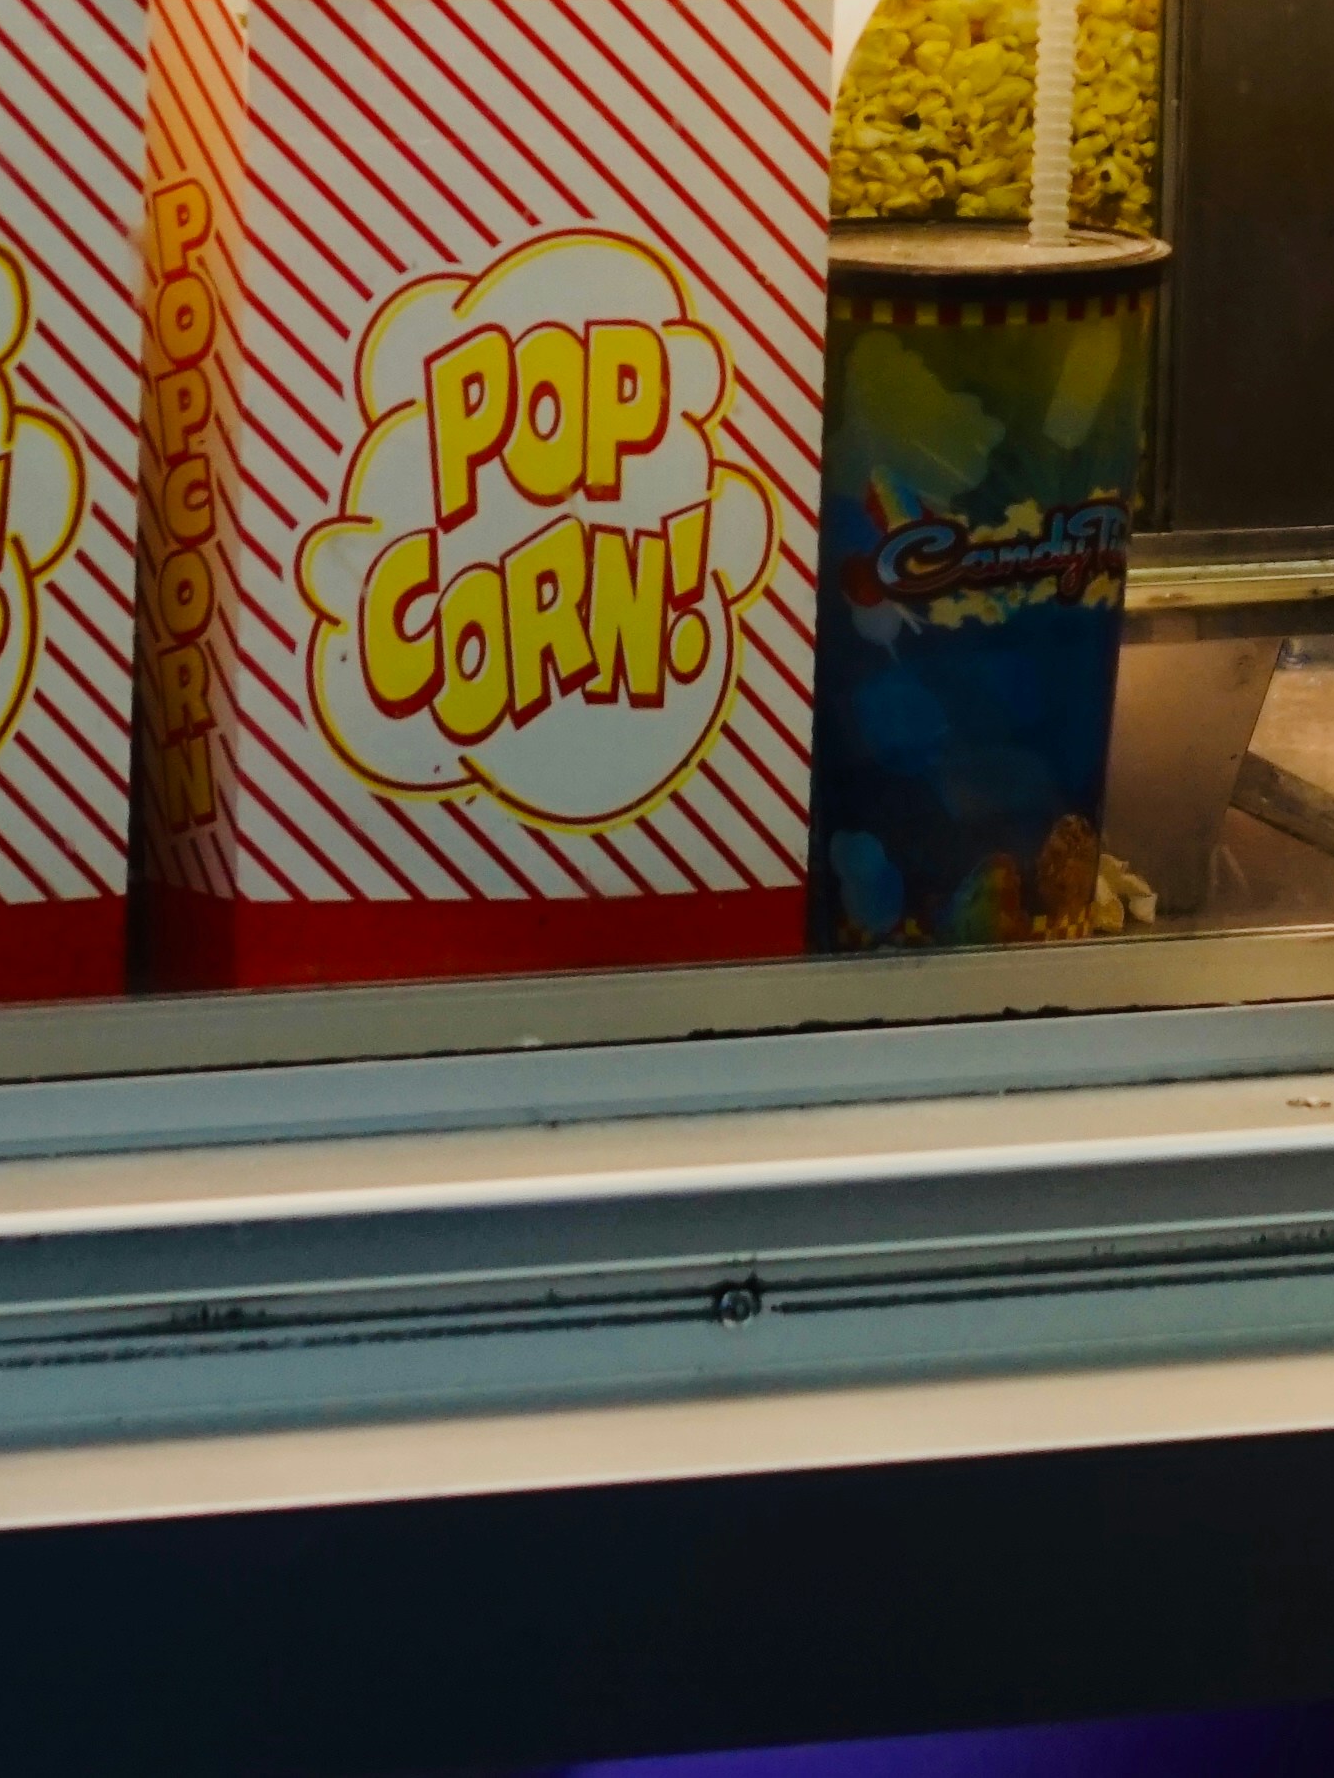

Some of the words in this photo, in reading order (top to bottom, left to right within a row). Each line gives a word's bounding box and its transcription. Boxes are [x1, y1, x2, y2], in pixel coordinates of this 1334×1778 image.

[151, 174, 217, 836] POPCORN
[424, 318, 668, 536] POP
[359, 499, 714, 748] CORN!
